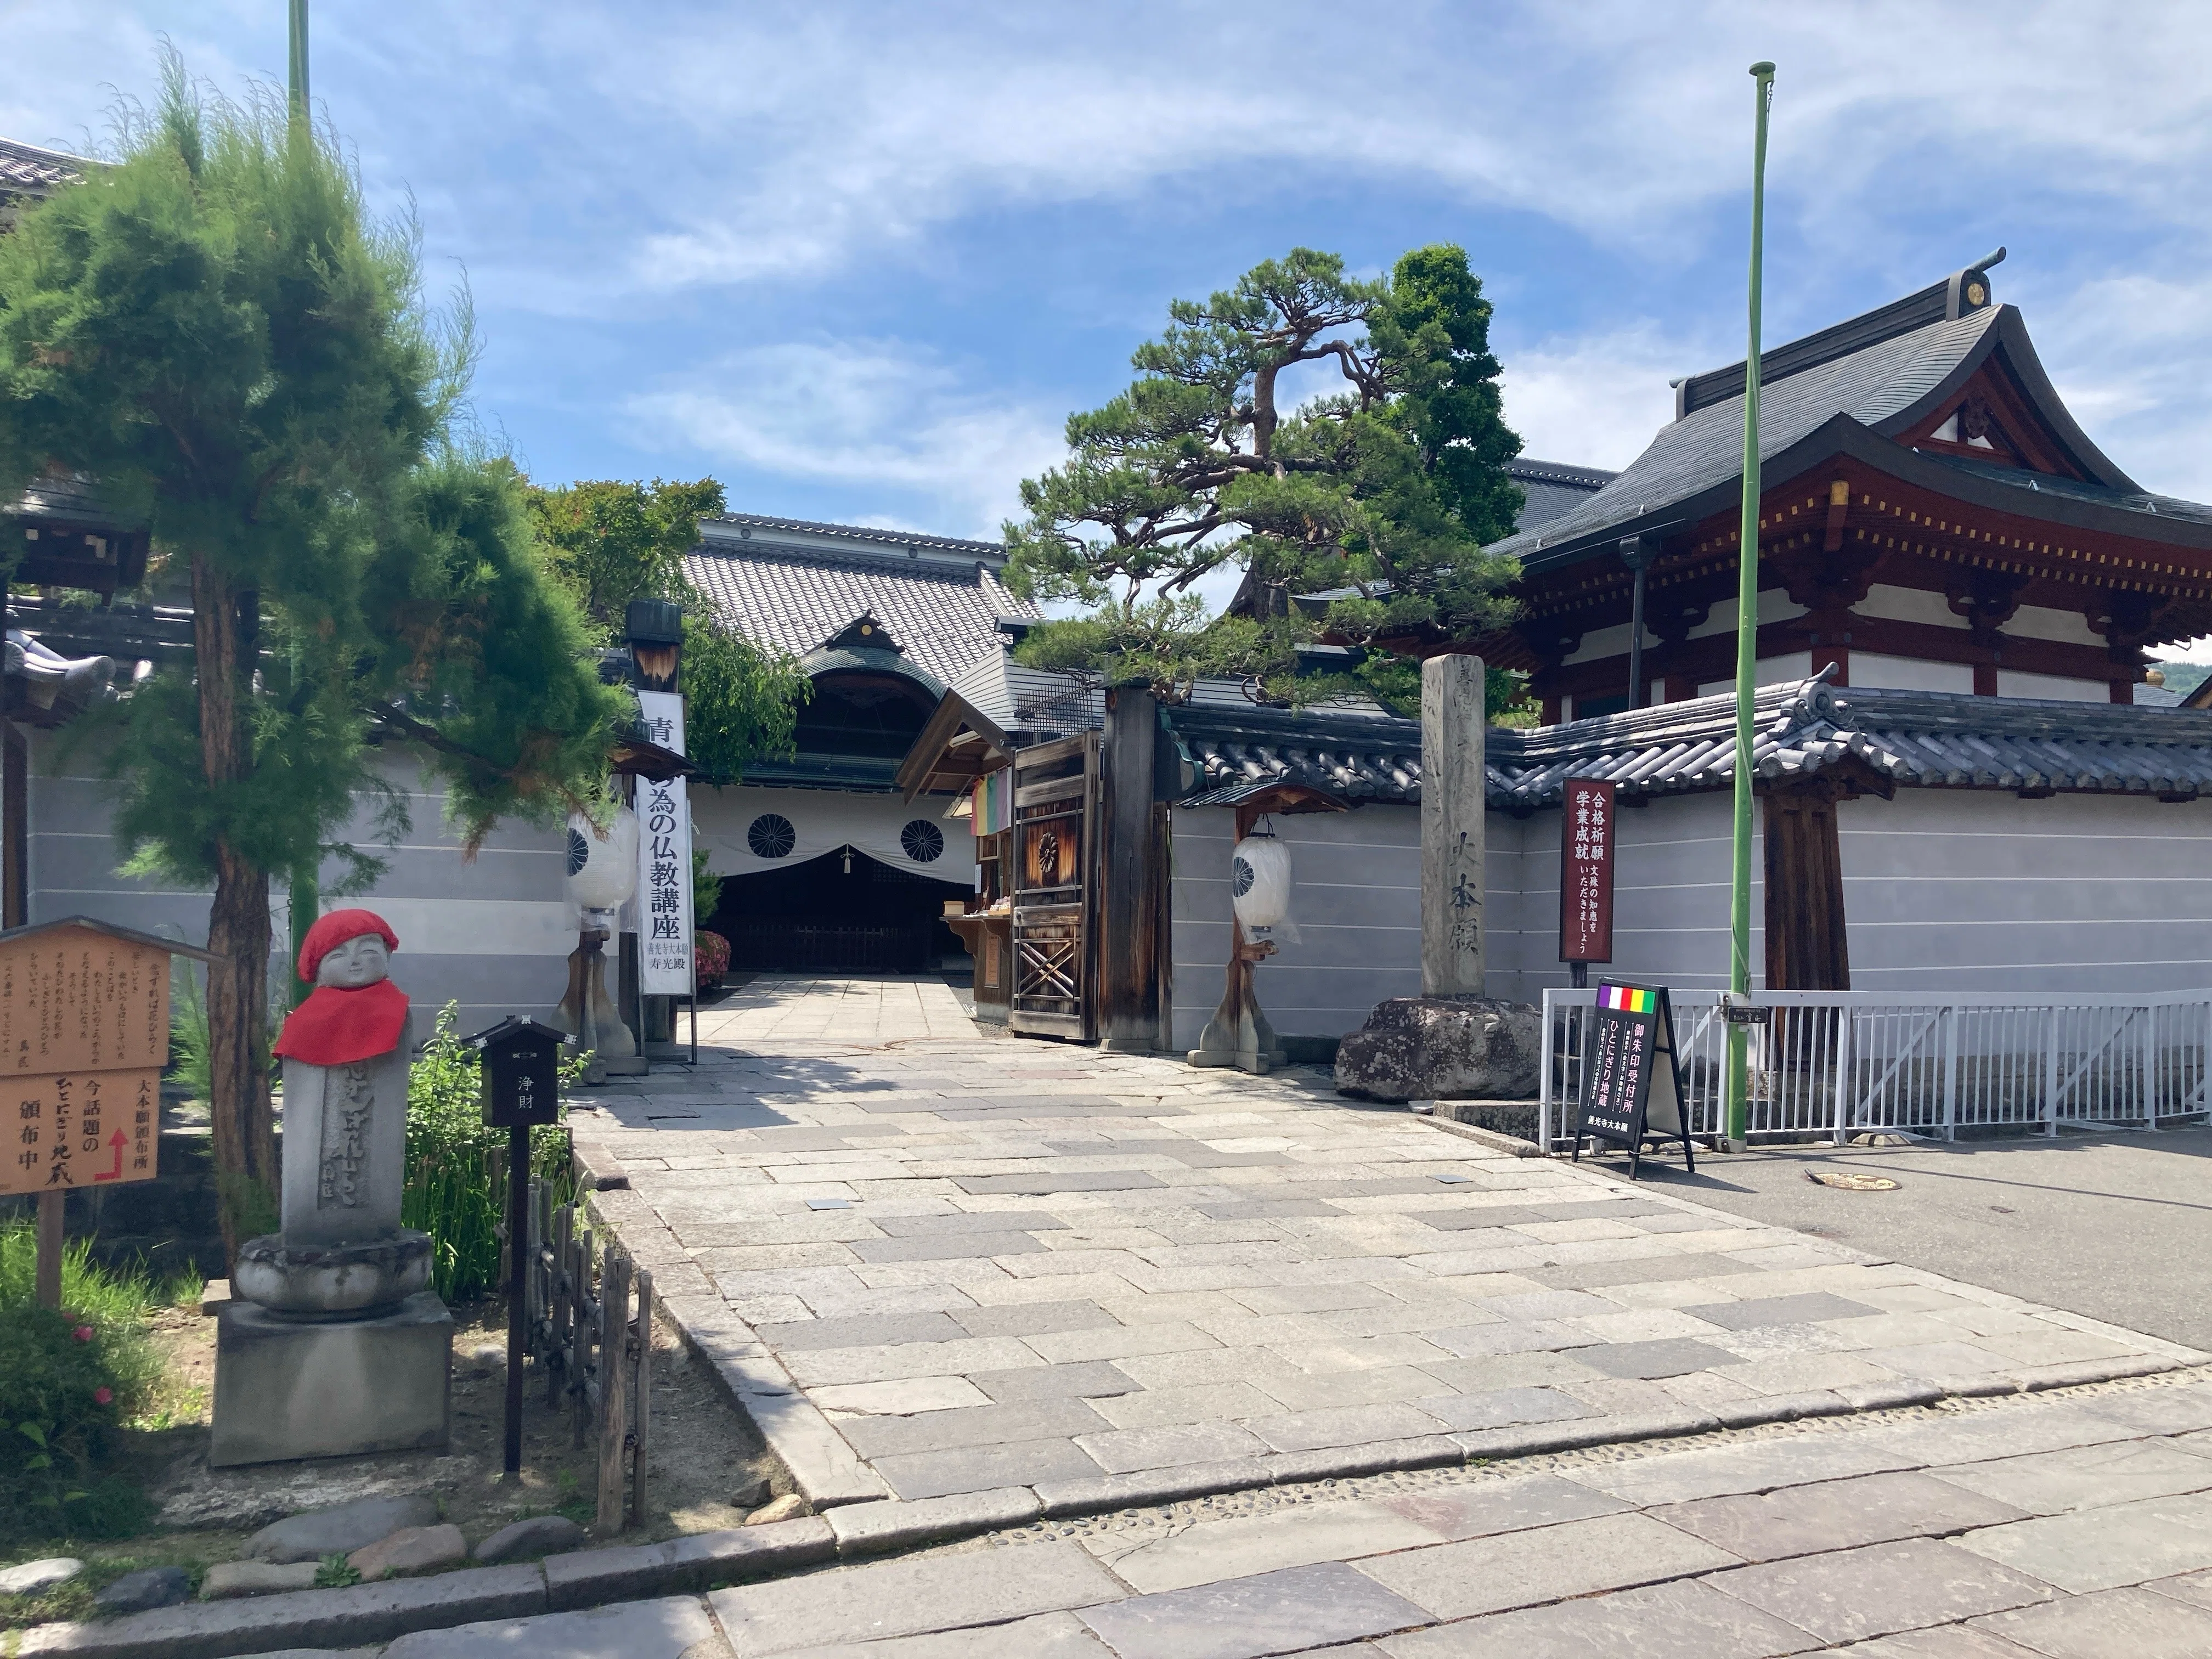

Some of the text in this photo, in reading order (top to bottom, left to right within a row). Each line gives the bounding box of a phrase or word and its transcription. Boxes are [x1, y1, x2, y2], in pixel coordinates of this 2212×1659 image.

[1590, 791, 1606, 861] 合格祈願
[1575, 790, 1590, 954] 学業成就 いただきましょう
[648, 942, 689, 955] 善光寺大本願
[518, 1075, 534, 1109] 浄財
[1598, 1020, 1619, 1107] ひとにぎり地蔵
[1622, 1023, 1645, 1114] 御朱印受付所
[18, 1099, 41, 1170] 頒布中
[83, 1080, 101, 1152] 今話題の
[134, 1079, 151, 1169] 大本願頒布所
[1588, 1115, 1629, 1132] 善光寺大本願
